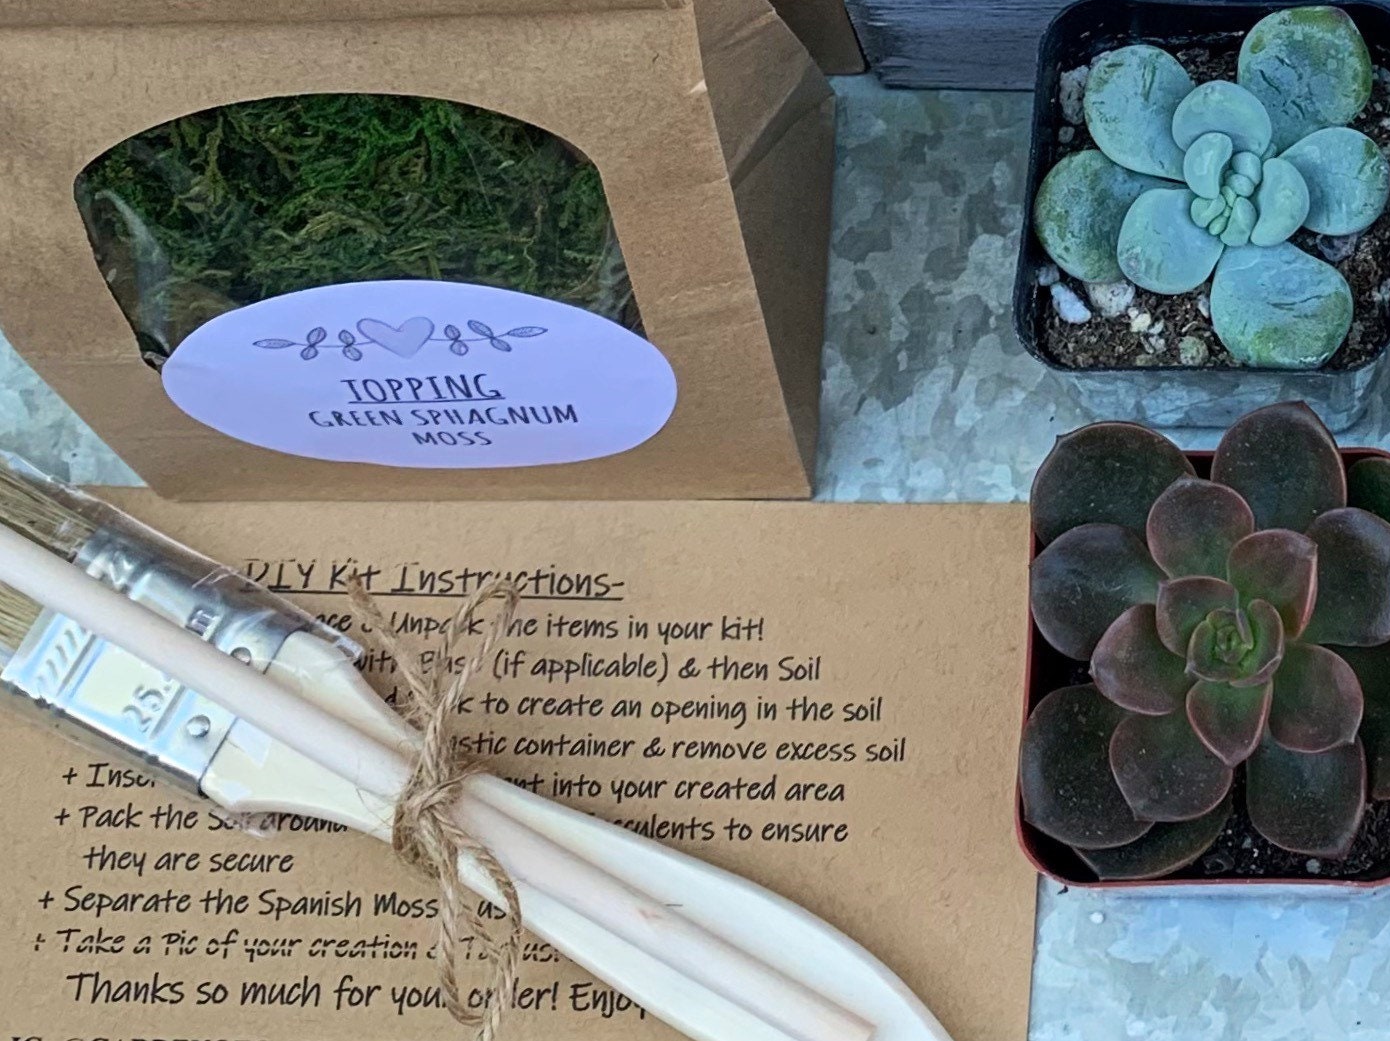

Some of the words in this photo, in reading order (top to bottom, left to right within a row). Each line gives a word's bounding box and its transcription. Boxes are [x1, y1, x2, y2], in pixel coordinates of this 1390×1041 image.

[340, 373, 503, 403] TOPPING
[308, 409, 403, 428] GREEN
[410, 403, 579, 427] SPHAGNUM
[411, 430, 493, 446] MOSS
[391, 611, 484, 640] Unpk
[505, 613, 538, 637] he
[546, 613, 618, 639] items
[627, 615, 648, 639] in
[657, 622, 713, 645] your
[721, 616, 764, 641] kit!
[493, 648, 525, 679] (if
[530, 652, 669, 684] applicable)
[678, 658, 702, 678] &
[707, 655, 769, 681] then
[778, 656, 821, 681] Soil
[480, 692, 509, 714] to
[517, 693, 603, 717] create
[611, 698, 642, 719] an
[650, 695, 747, 729] opening
[757, 696, 777, 720] in
[786, 696, 834, 722] the
[843, 696, 882, 722] soil
[514, 732, 635, 758] container
[643, 737, 666, 758] &
[671, 739, 767, 761] remove
[775, 741, 857, 763] excess
[865, 737, 906, 762] soil
[86, 762, 155, 788] Inse
[552, 772, 601, 798] into
[610, 779, 667, 803] your
[674, 774, 777, 802] created
[784, 779, 845, 802] area
[79, 802, 143, 828] Pack
[150, 803, 199, 830] the
[588, 812, 715, 841] culents
[723, 817, 752, 842] to
[761, 821, 849, 843] ensure
[83, 845, 146, 877] they
[153, 850, 200, 871] are
[209, 851, 294, 874] secure
[63, 885, 191, 917] Separate
[199, 888, 249, 914] the
[258, 888, 362, 921] Spanish
[373, 892, 438, 918] Moss
[56, 927, 126, 953] Take
[133, 935, 151, 954] a
[161, 930, 199, 956] Pic
[205, 928, 240, 958] of
[244, 938, 303, 963] your
[308, 934, 418, 959] creation
[66, 971, 185, 1005] Thanks
[196, 980, 229, 1005] so
[240, 975, 321, 1008] much
[333, 975, 381, 1010] for
[391, 985, 447, 1016] you
